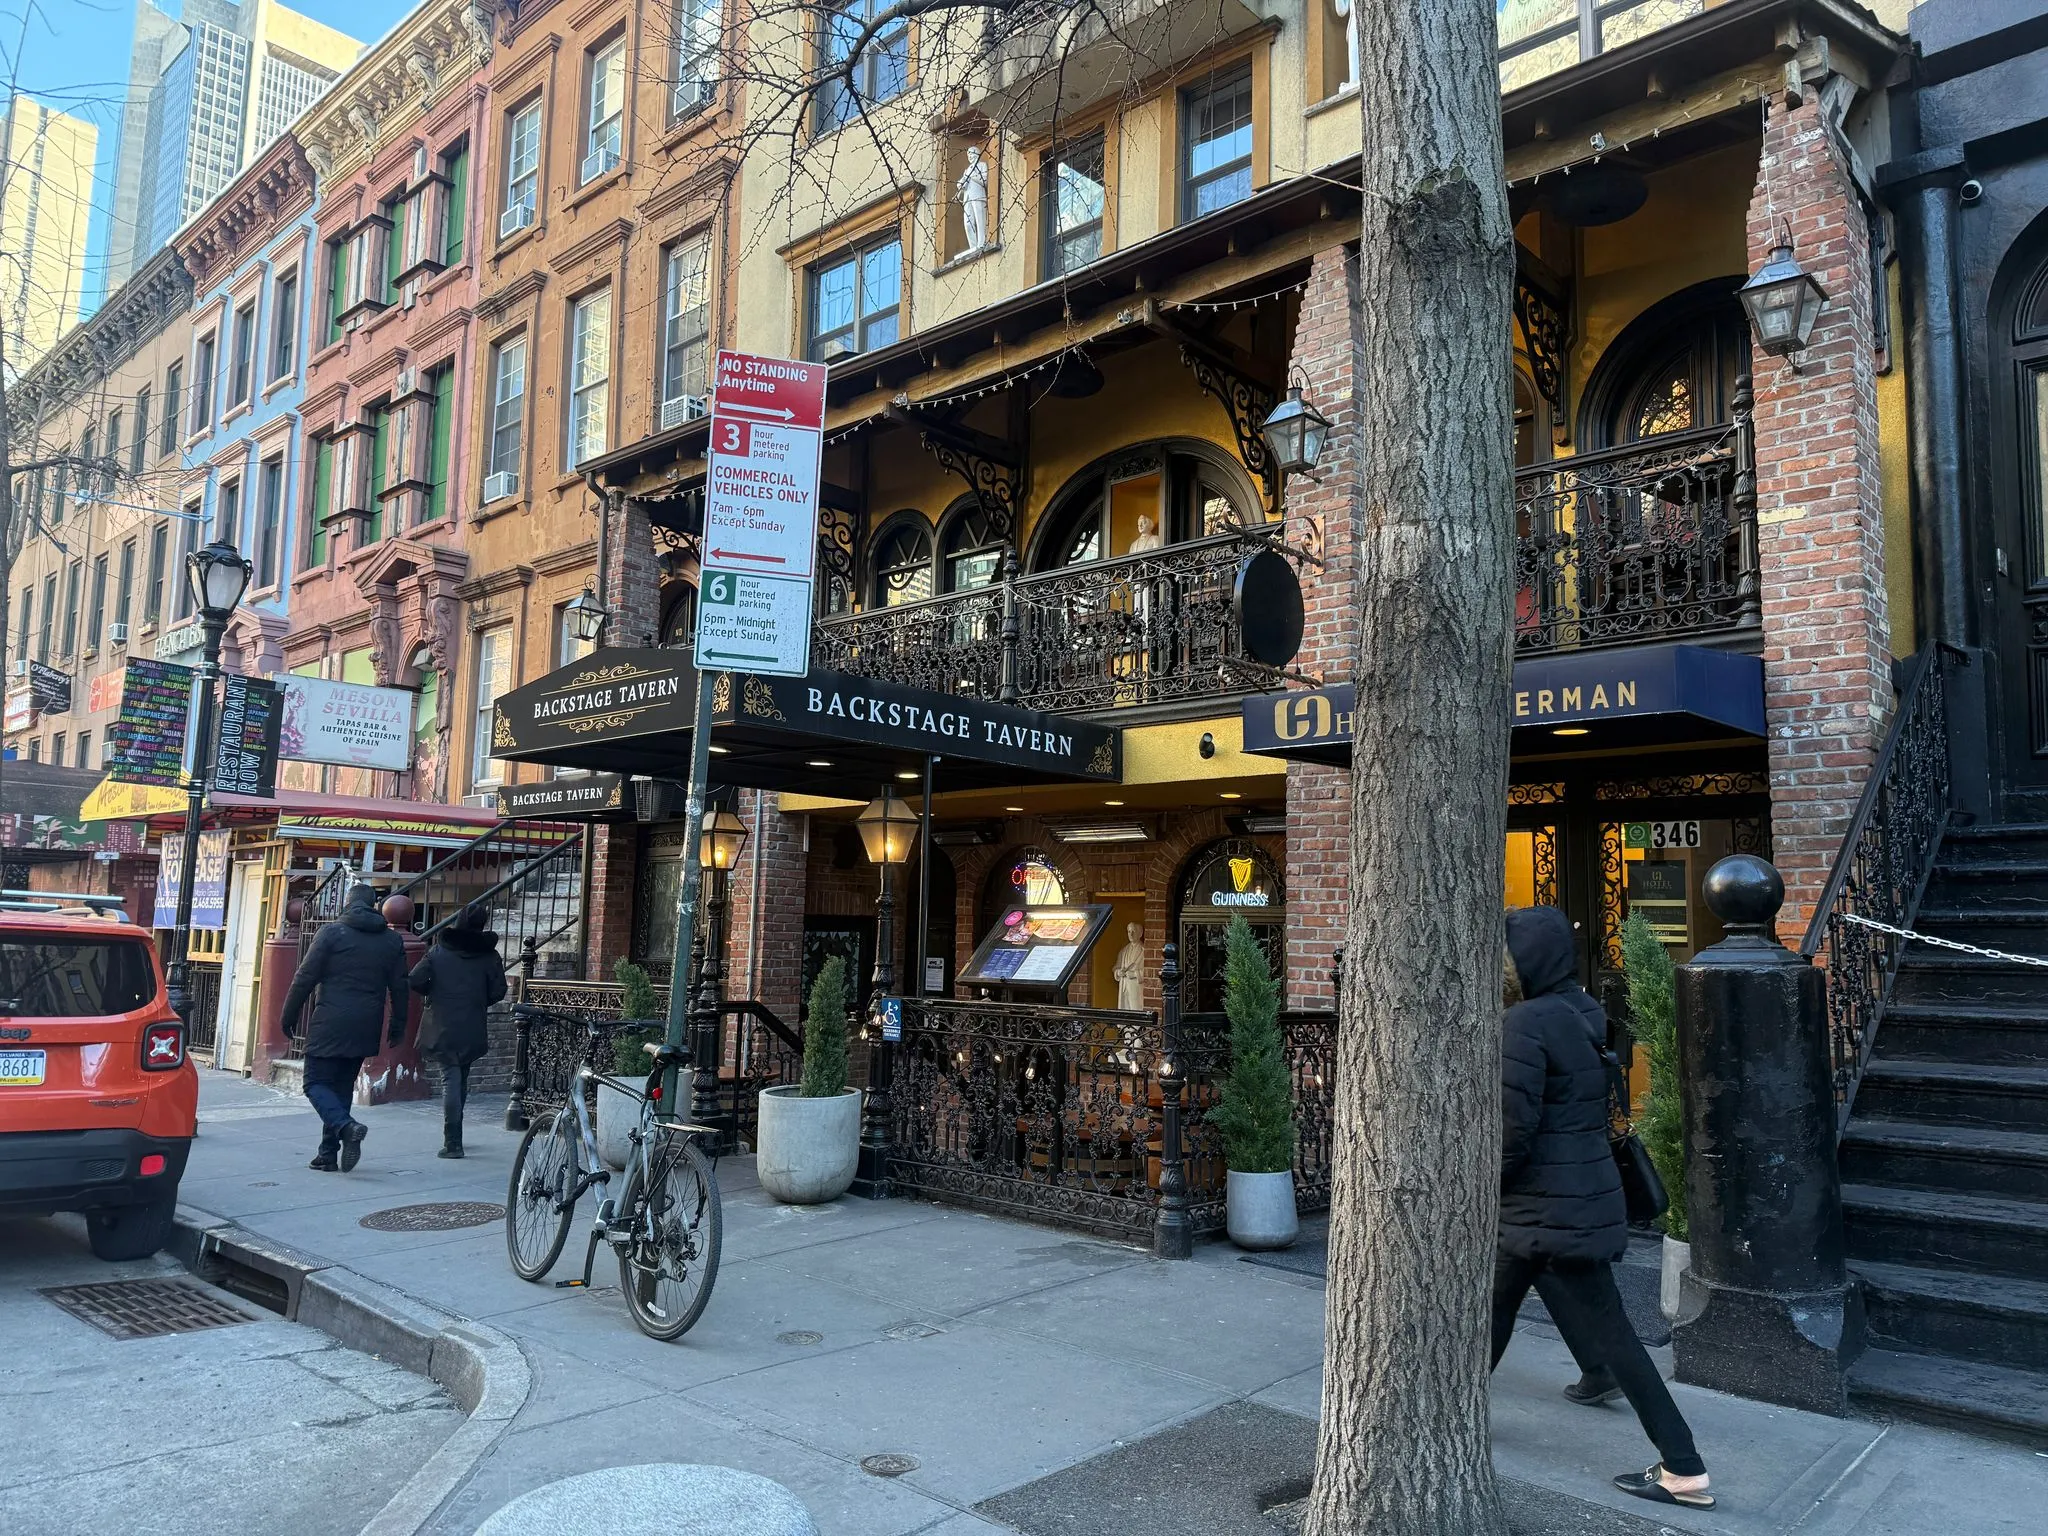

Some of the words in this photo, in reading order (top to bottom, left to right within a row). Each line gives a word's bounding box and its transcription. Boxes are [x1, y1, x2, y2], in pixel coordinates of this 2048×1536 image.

[722, 358, 742, 373] NO
[745, 362, 808, 382] STANDING
[722, 374, 776, 394] Anytime
[722, 423, 740, 451] 3
[754, 428, 774, 440] hour
[753, 439, 790, 451] metered
[753, 449, 785, 462] parking
[715, 465, 796, 487] COMMERCIAL
[714, 481, 774, 501] VEHICLES
[777, 489, 809, 505] ONLY
[712, 501, 733, 514] 7am
[743, 506, 765, 519] 6pm
[711, 514, 745, 529] Except
[748, 518, 786, 534] Sunday
[709, 574, 727, 601] 6
[740, 578, 760, 589] hour
[739, 589, 776, 601] metered
[738, 599, 772, 611] parking
[704, 612, 726, 626] 6pm
[736, 615, 776, 630] Midnight
[702, 625, 738, 639] Except
[740, 629, 778, 644] Sunday
[162, 680, 190, 690] AMERICAN
[129, 700, 153, 709] FRENCH
[329, 687, 398, 709] MESON
[534, 689, 612, 719] BACKSTAGE
[619, 677, 679, 704] TAVERN
[1515, 680, 1637, 717] ERMAN
[120, 715, 150, 725] AMERICAN
[322, 701, 403, 724] SEVILLA
[336, 719, 361, 728] TAPAS
[363, 722, 379, 731] BAR
[807, 687, 971, 739] BACKSTAGE
[983, 720, 1073, 757] TAVERN
[162, 729, 181, 737] INDIAN
[216, 674, 248, 792] RESTAURANT
[320, 725, 367, 738] AUTHENTIC
[369, 731, 402, 741] CUISINE
[342, 736, 352, 744] OF
[355, 738, 380, 747] SPAIN
[164, 745, 183, 753] FRENC
[151, 768, 180, 778] AMERICAN
[238, 752, 260, 794] ROW
[513, 789, 562, 806] BACKSTAGE
[566, 787, 603, 801] TAVERN
[1653, 821, 1699, 848] 346
[166, 859, 182, 883] FO
[195, 857, 222, 883] EASE
[1212, 891, 1267, 906] GUINNESS
[0, 1028, 32, 1041] eep
[2, 1059, 37, 1077] 8681
